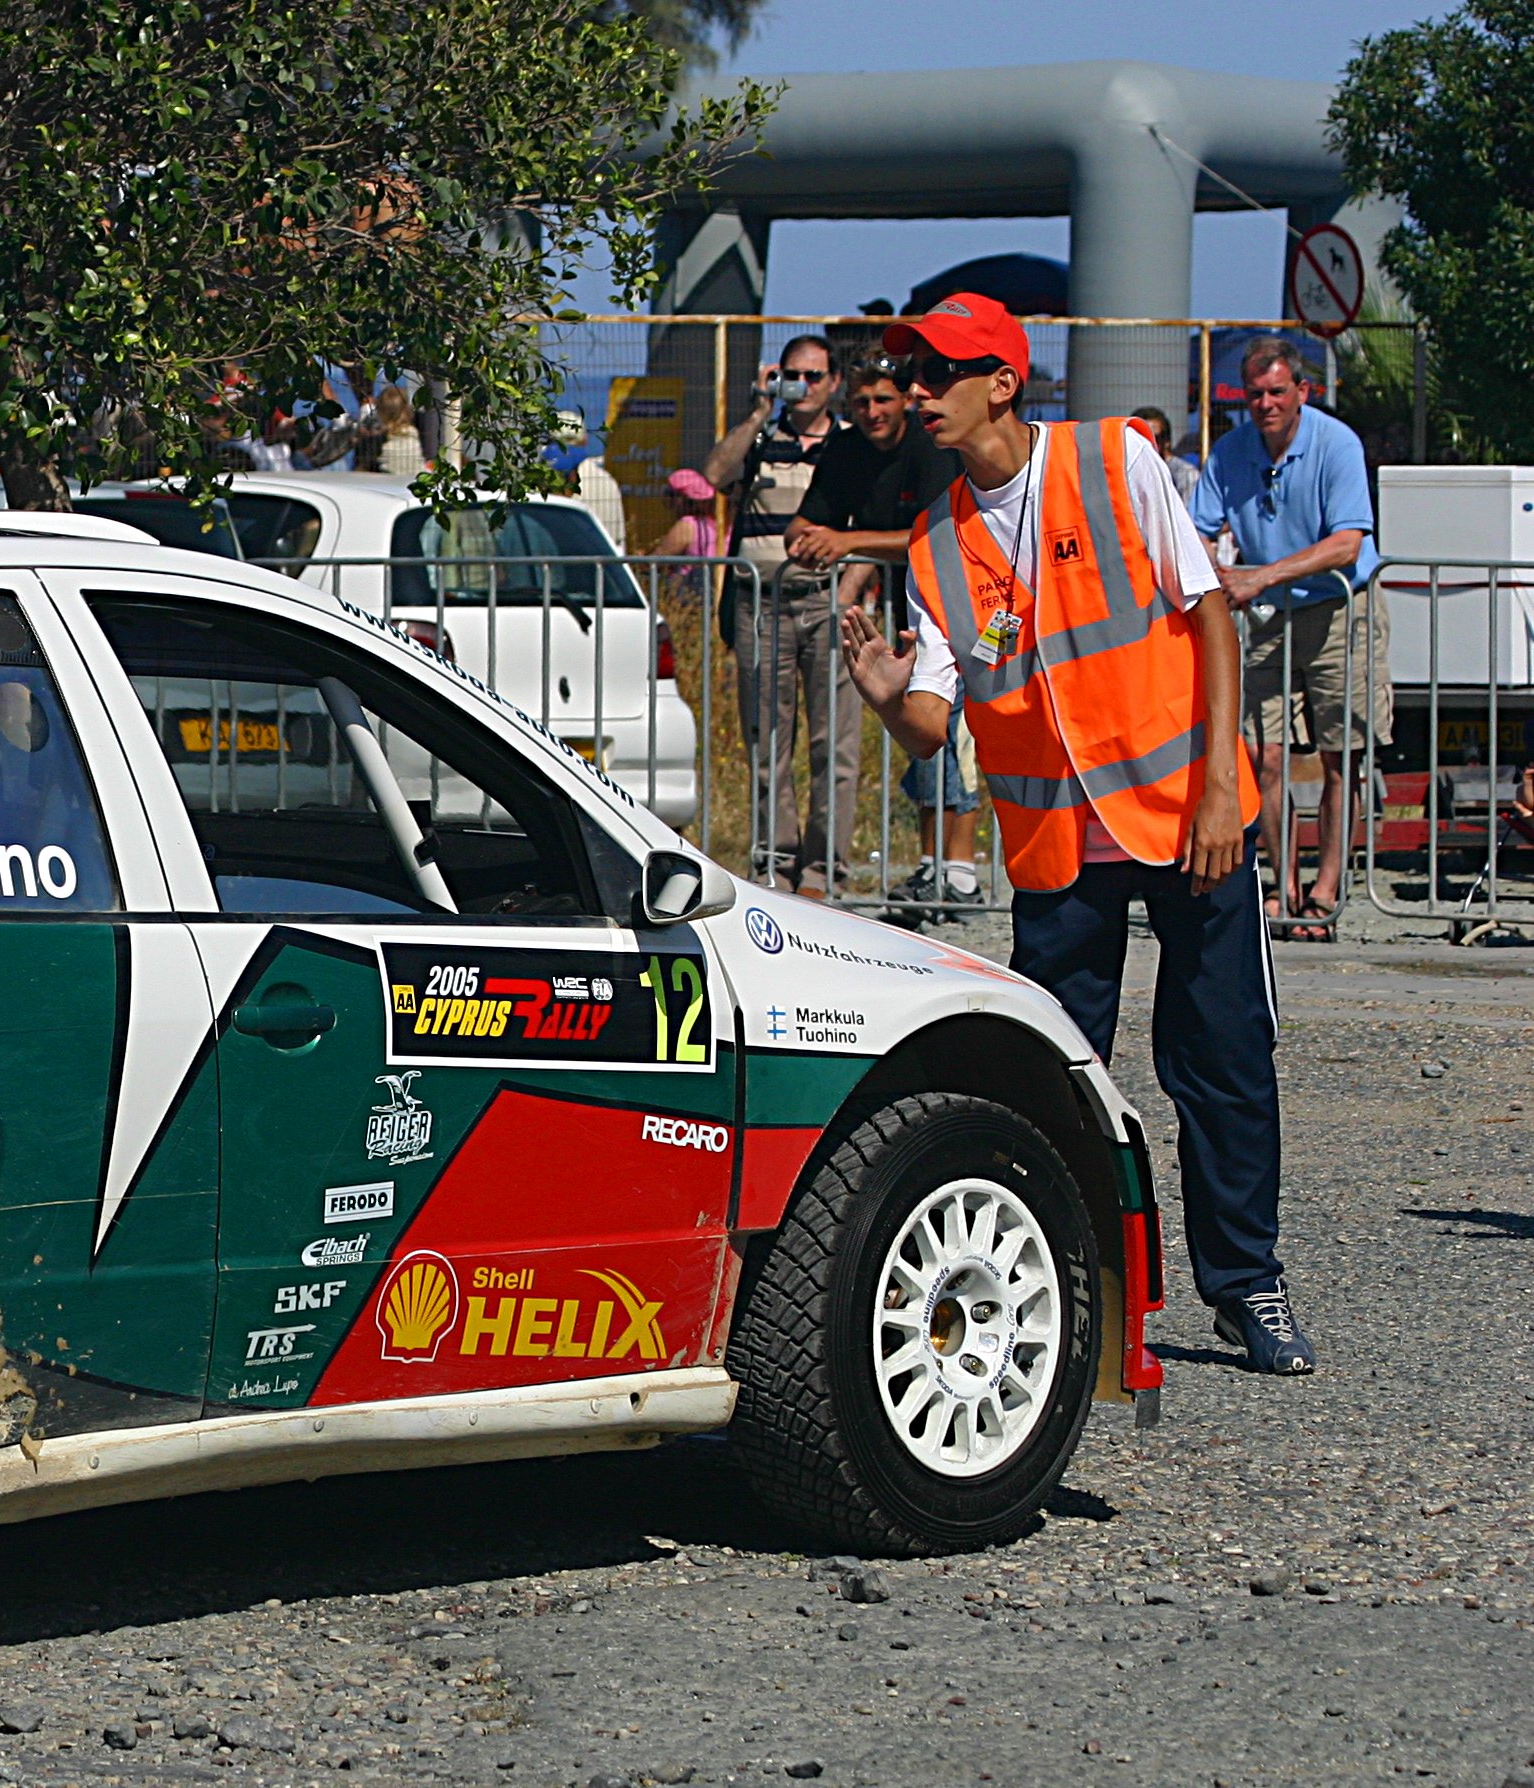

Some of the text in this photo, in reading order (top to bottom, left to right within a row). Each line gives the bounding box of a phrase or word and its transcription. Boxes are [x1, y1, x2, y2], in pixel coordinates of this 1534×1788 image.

[1054, 538, 1080, 563] AA
[339, 600, 636, 809] www.skoda-auto.com
[786, 931, 934, 975] Nutzfahrzeuge
[425, 965, 480, 997] 2005
[396, 992, 415, 1011] AA
[414, 977, 613, 1041] CYPRUS RALLY
[639, 955, 706, 1062] 12
[796, 1007, 865, 1026] Markkula
[796, 1026, 858, 1044] Tuohino
[367, 1111, 432, 1146] REIGER
[642, 1113, 729, 1154] RECARO
[368, 1137, 424, 1159] Racing
[330, 1191, 389, 1213] FERODO
[316, 1252, 362, 1267] SPRINGS
[472, 1265, 534, 1292] Shell
[274, 1280, 347, 1314] SKF
[460, 1267, 668, 1360] HELIX
[246, 1328, 299, 1360] TRS
